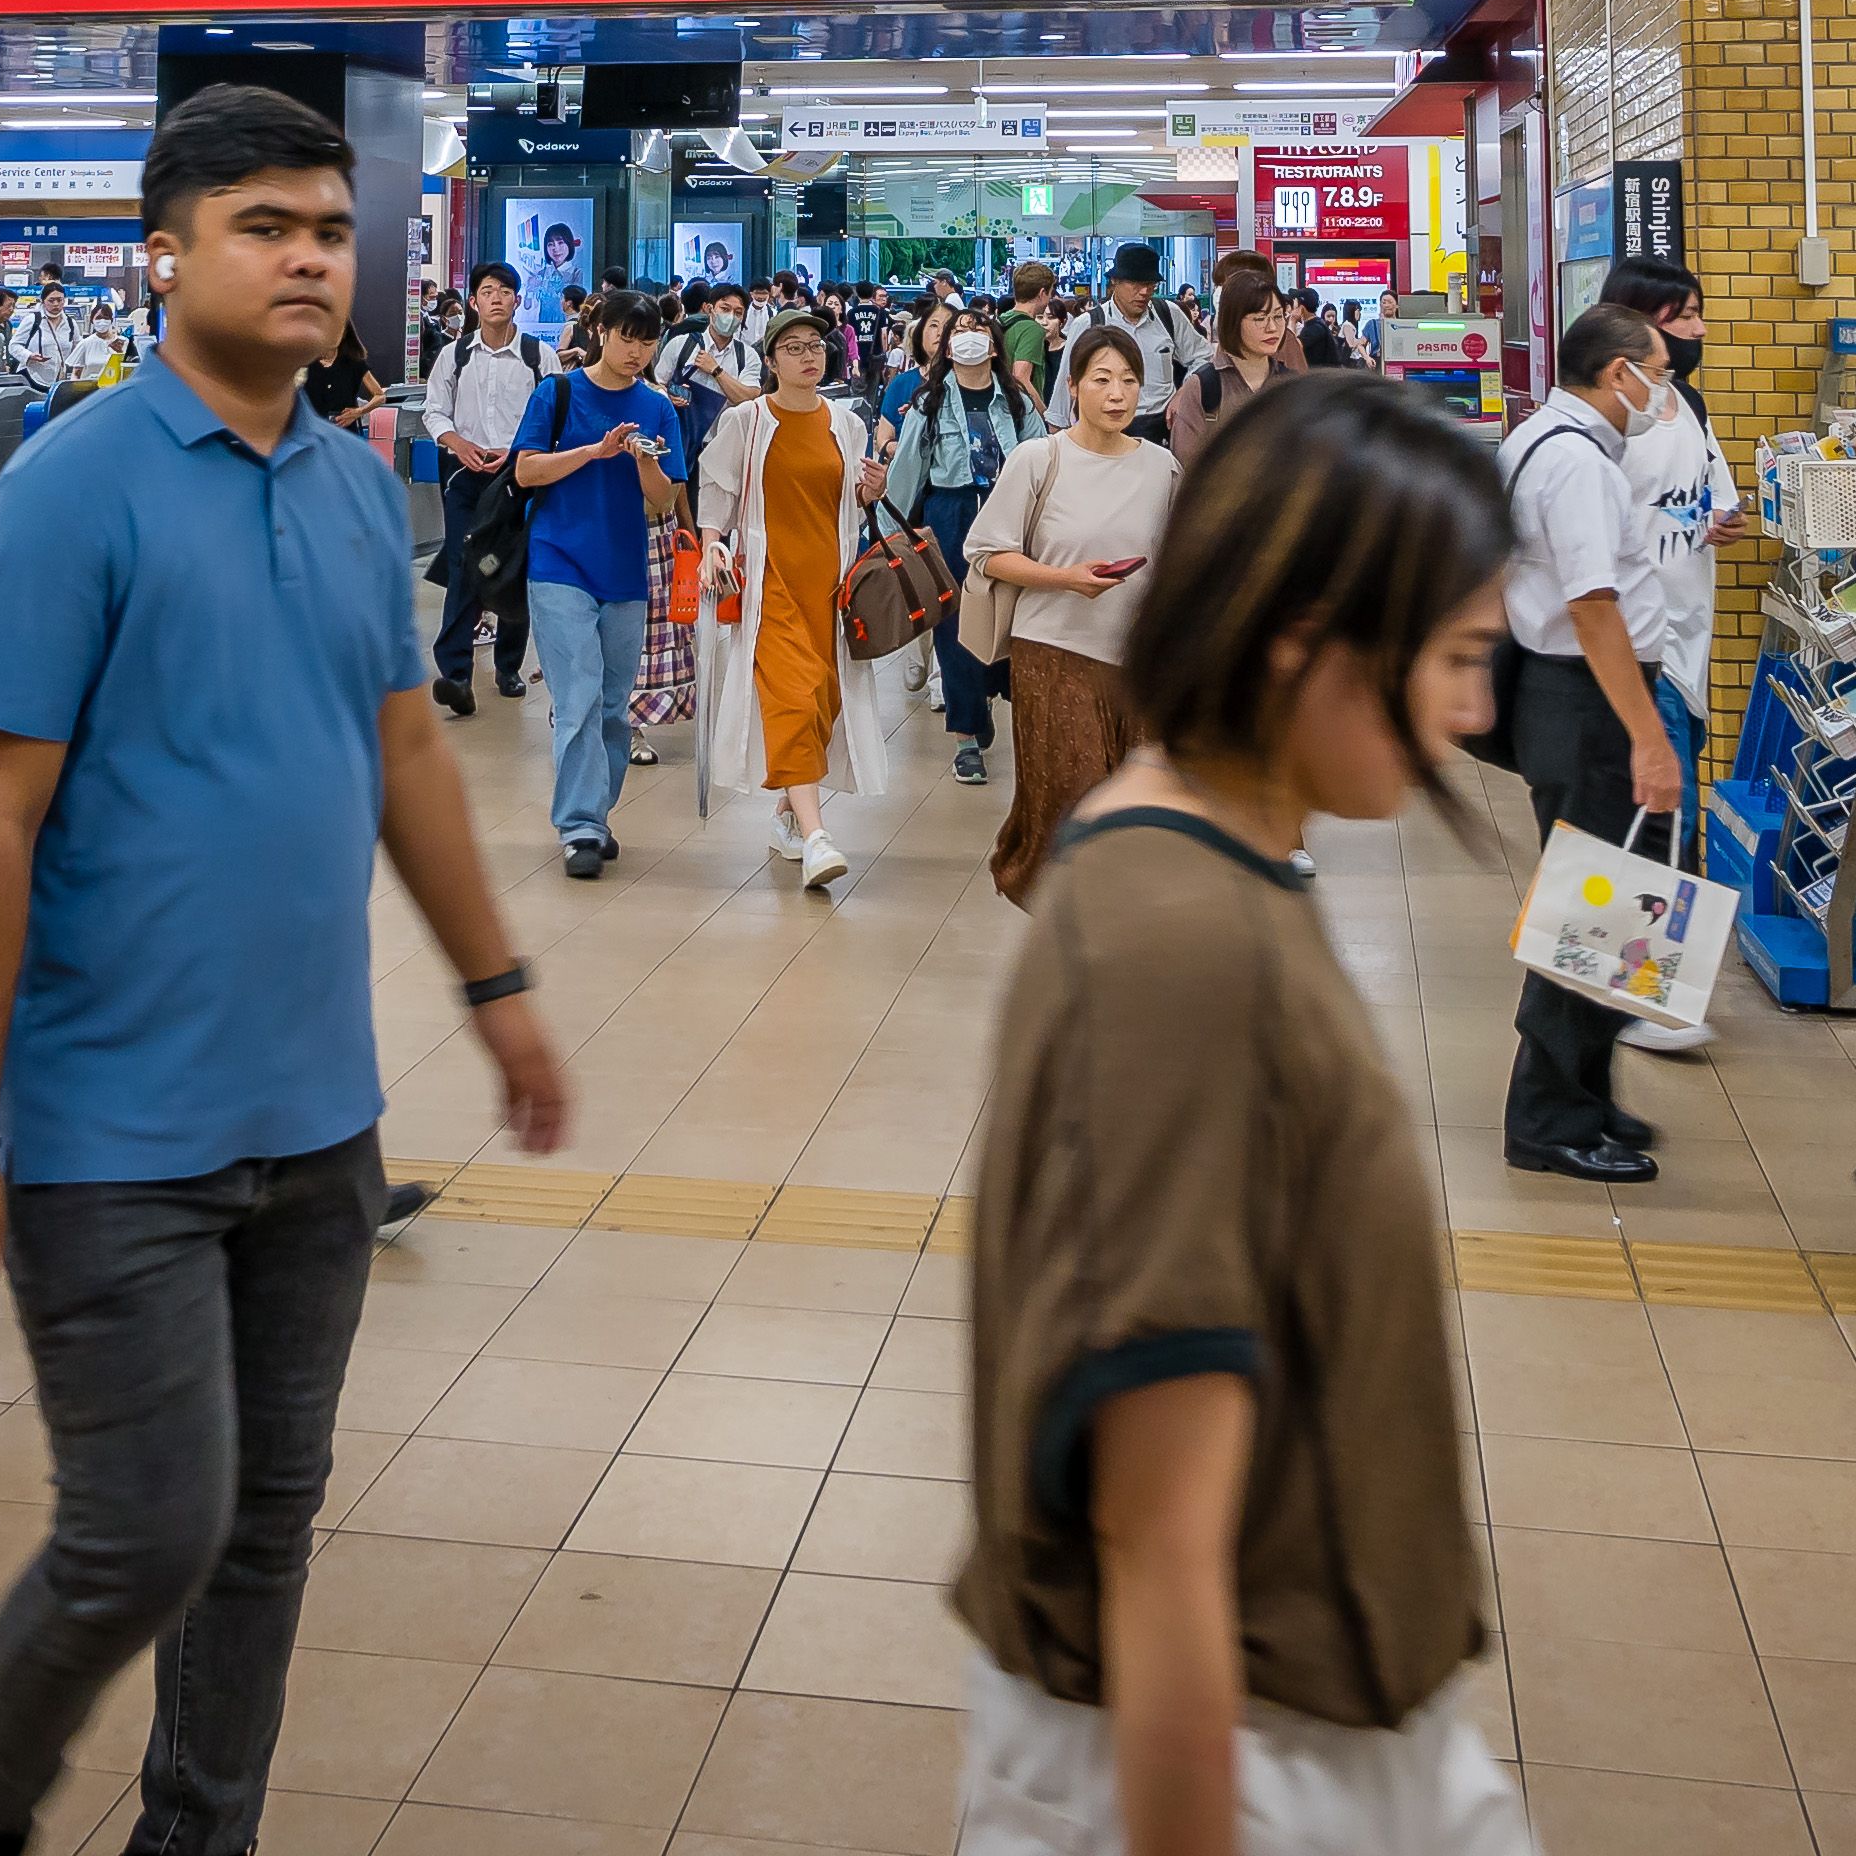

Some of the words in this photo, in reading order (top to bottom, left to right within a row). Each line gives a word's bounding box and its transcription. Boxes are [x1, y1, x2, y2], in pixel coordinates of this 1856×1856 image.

[34, 167, 66, 177] Center
[1274, 165, 1383, 178] RESTAURANTS
[1324, 217, 1383, 227] 11:00-22:00
[1647, 177, 1672, 260] Shinjuk
[1417, 342, 1458, 352] PASMO
